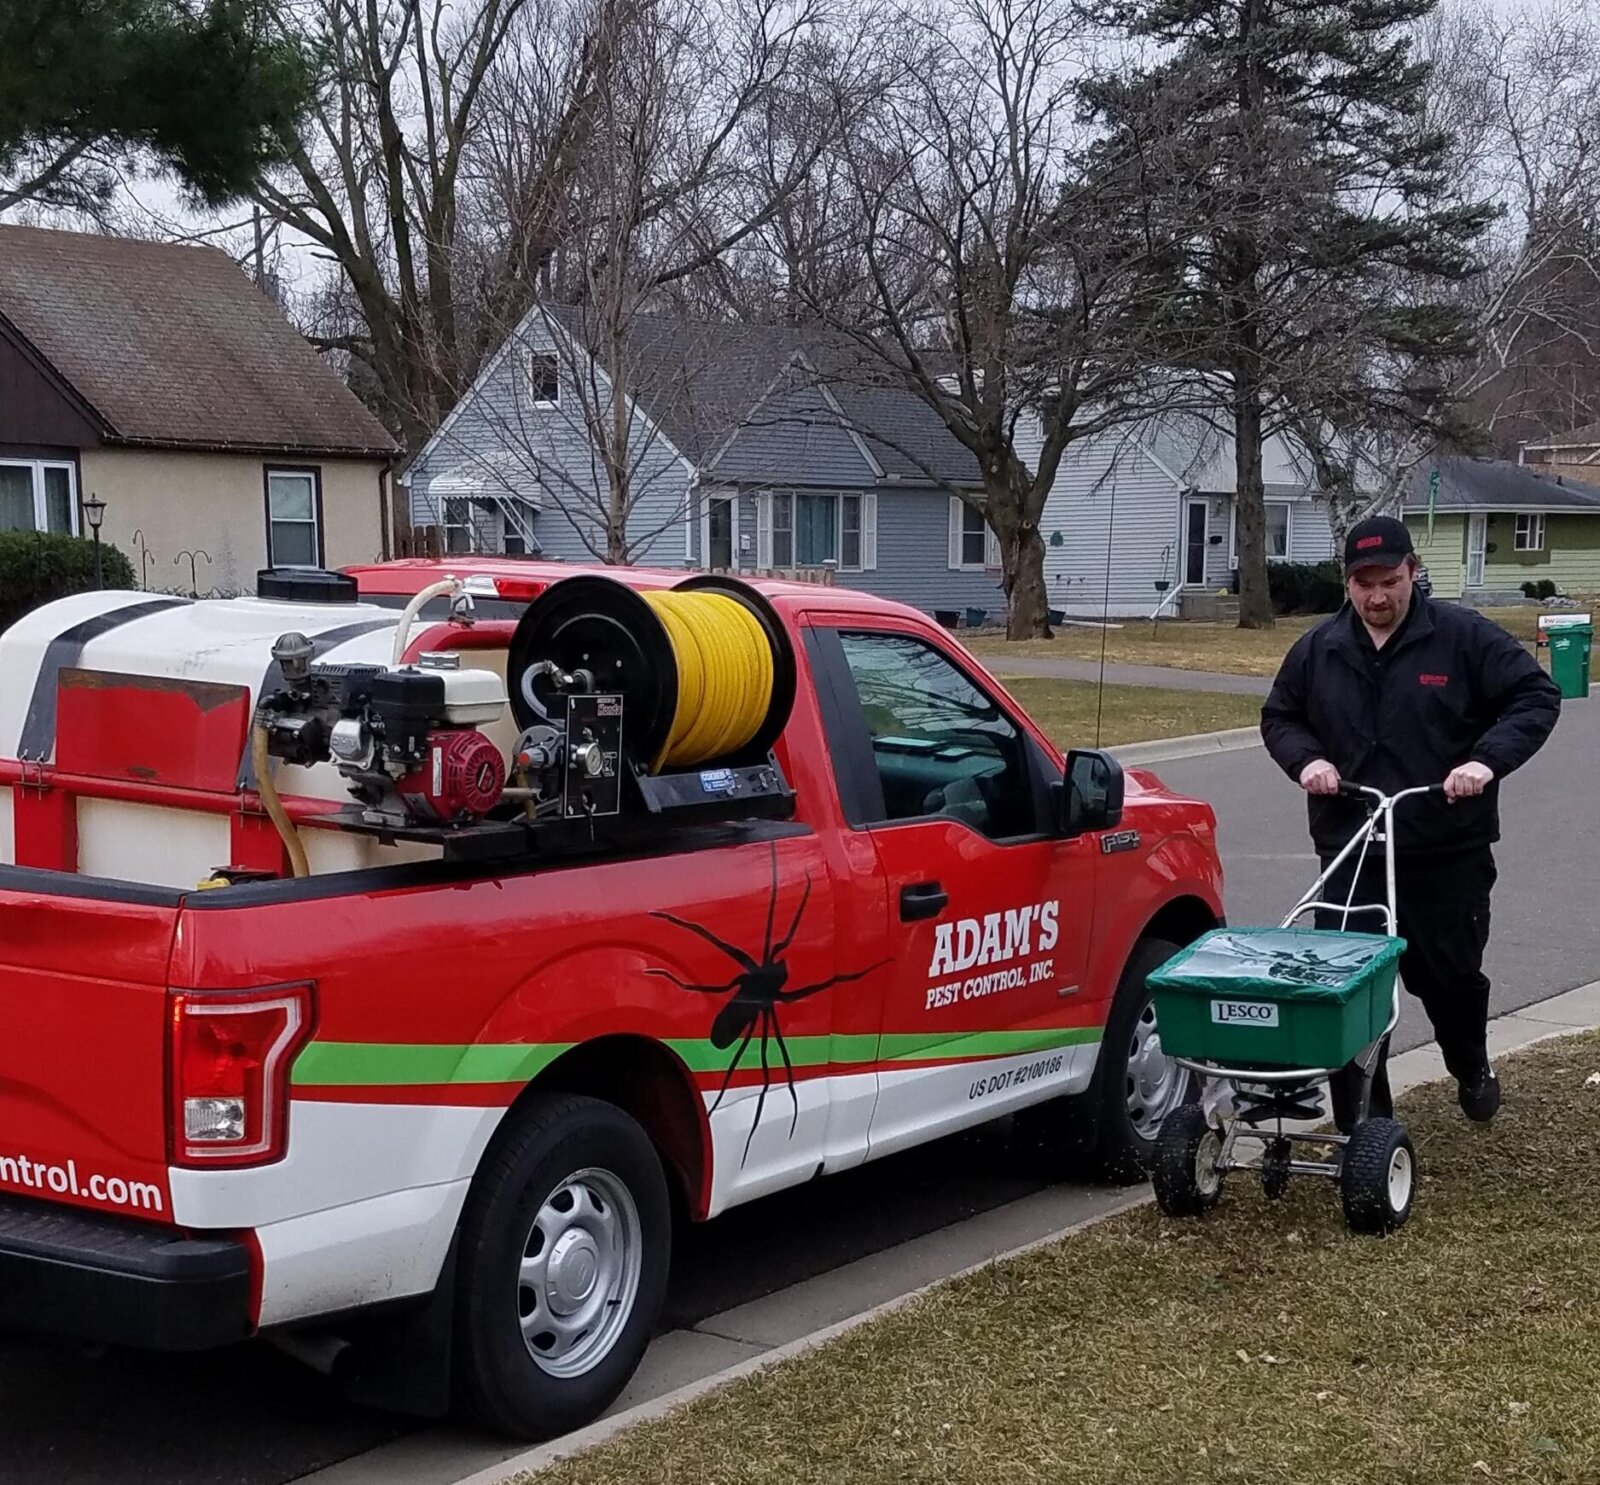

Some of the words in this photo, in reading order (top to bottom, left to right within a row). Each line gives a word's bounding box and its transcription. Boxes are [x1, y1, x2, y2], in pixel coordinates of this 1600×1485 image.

[928, 900, 1059, 978] ADAM'S
[925, 982, 962, 1010] PEST
[963, 967, 1027, 1000] CONTROL,
[1029, 959, 1055, 984] INC.
[969, 1079, 986, 1100] US
[988, 1070, 1014, 1094] DOT
[1013, 1055, 1063, 1086] #2100186
